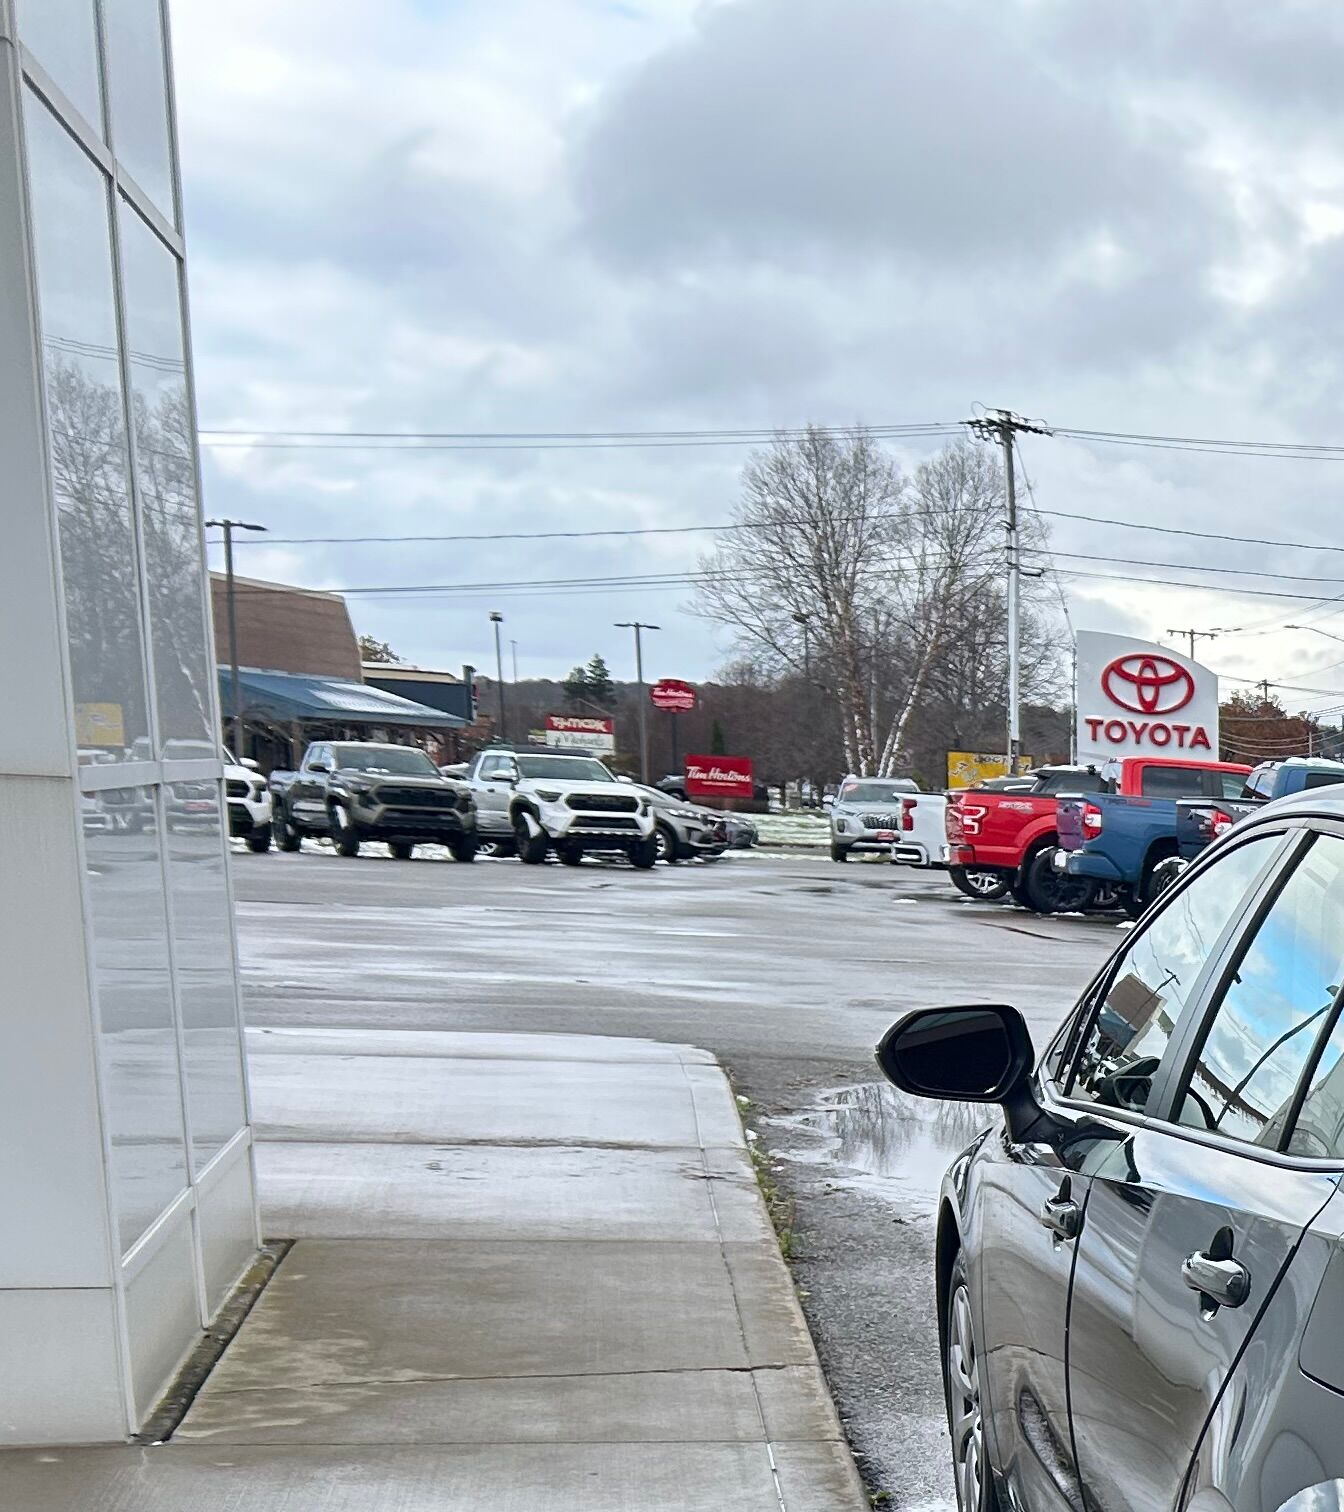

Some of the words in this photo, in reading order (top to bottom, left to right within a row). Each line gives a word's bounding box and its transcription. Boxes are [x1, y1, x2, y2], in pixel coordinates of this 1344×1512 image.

[1085, 718, 1212, 750] TOYOTA
[686, 766, 707, 780] Tim
[708, 767, 752, 782] Hortons
